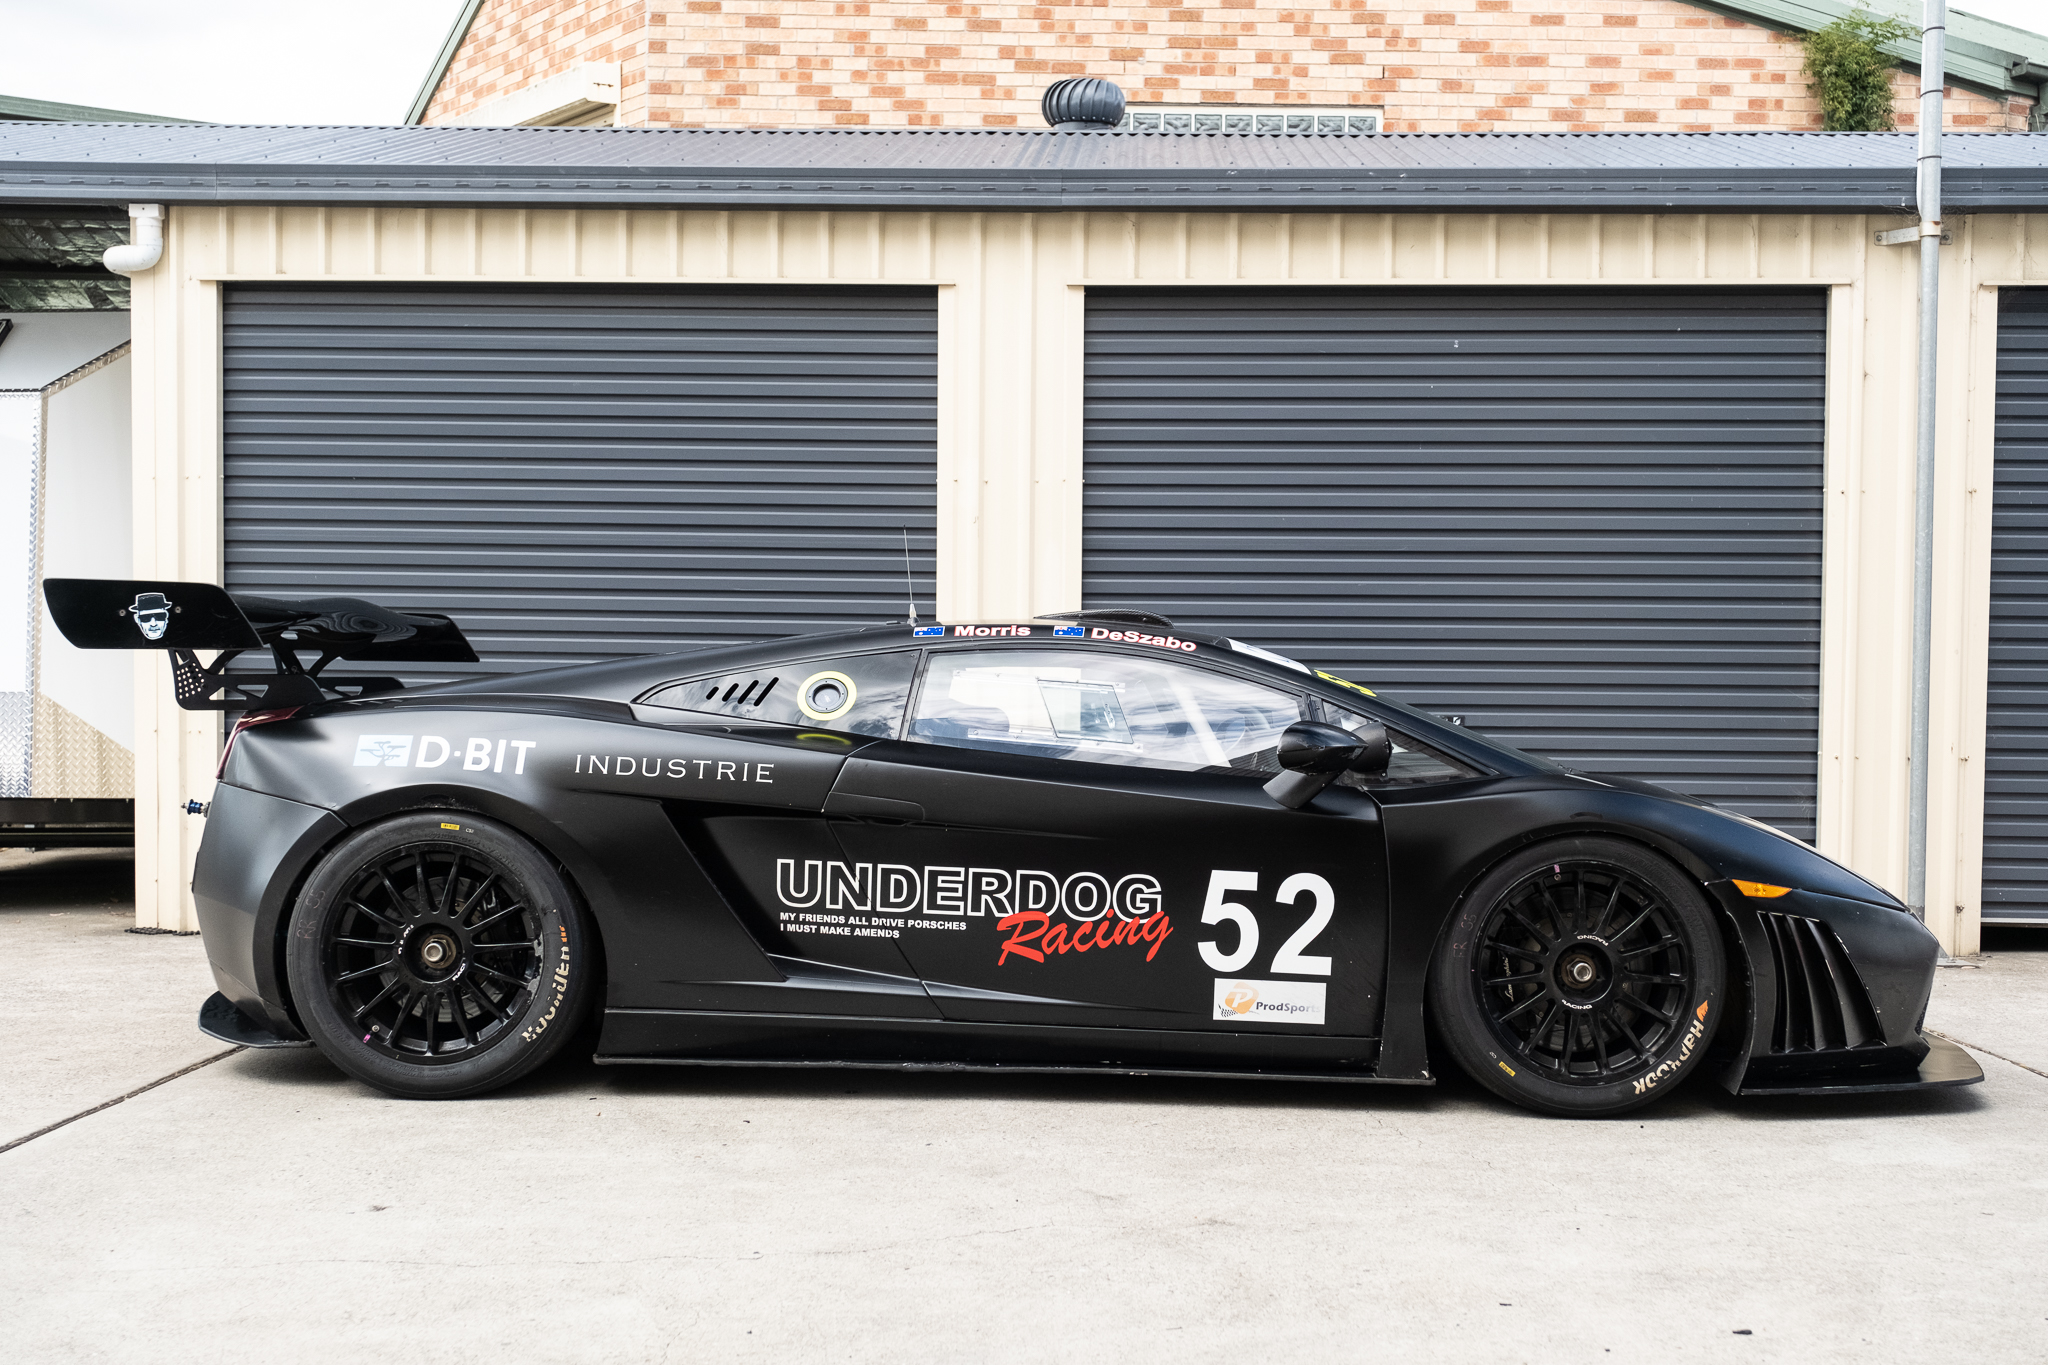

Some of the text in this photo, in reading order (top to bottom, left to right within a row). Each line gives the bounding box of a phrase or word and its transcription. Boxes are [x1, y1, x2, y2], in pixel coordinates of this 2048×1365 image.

[954, 625, 1031, 637] Morris
[1091, 627, 1197, 651] DeSzabo
[574, 754, 775, 784] INDUSTRIE
[776, 858, 1162, 924] UNDERDOG
[780, 912, 967, 931] MY FRIENDS ALL DRIVE PORSCHES
[786, 923, 817, 934] MUST
[819, 925, 851, 936] MAKE
[853, 927, 900, 939] AMENDS
[1197, 869, 1336, 976] 52
[996, 908, 1174, 966] Racing
[1256, 1001, 1321, 1014] ProdSports
